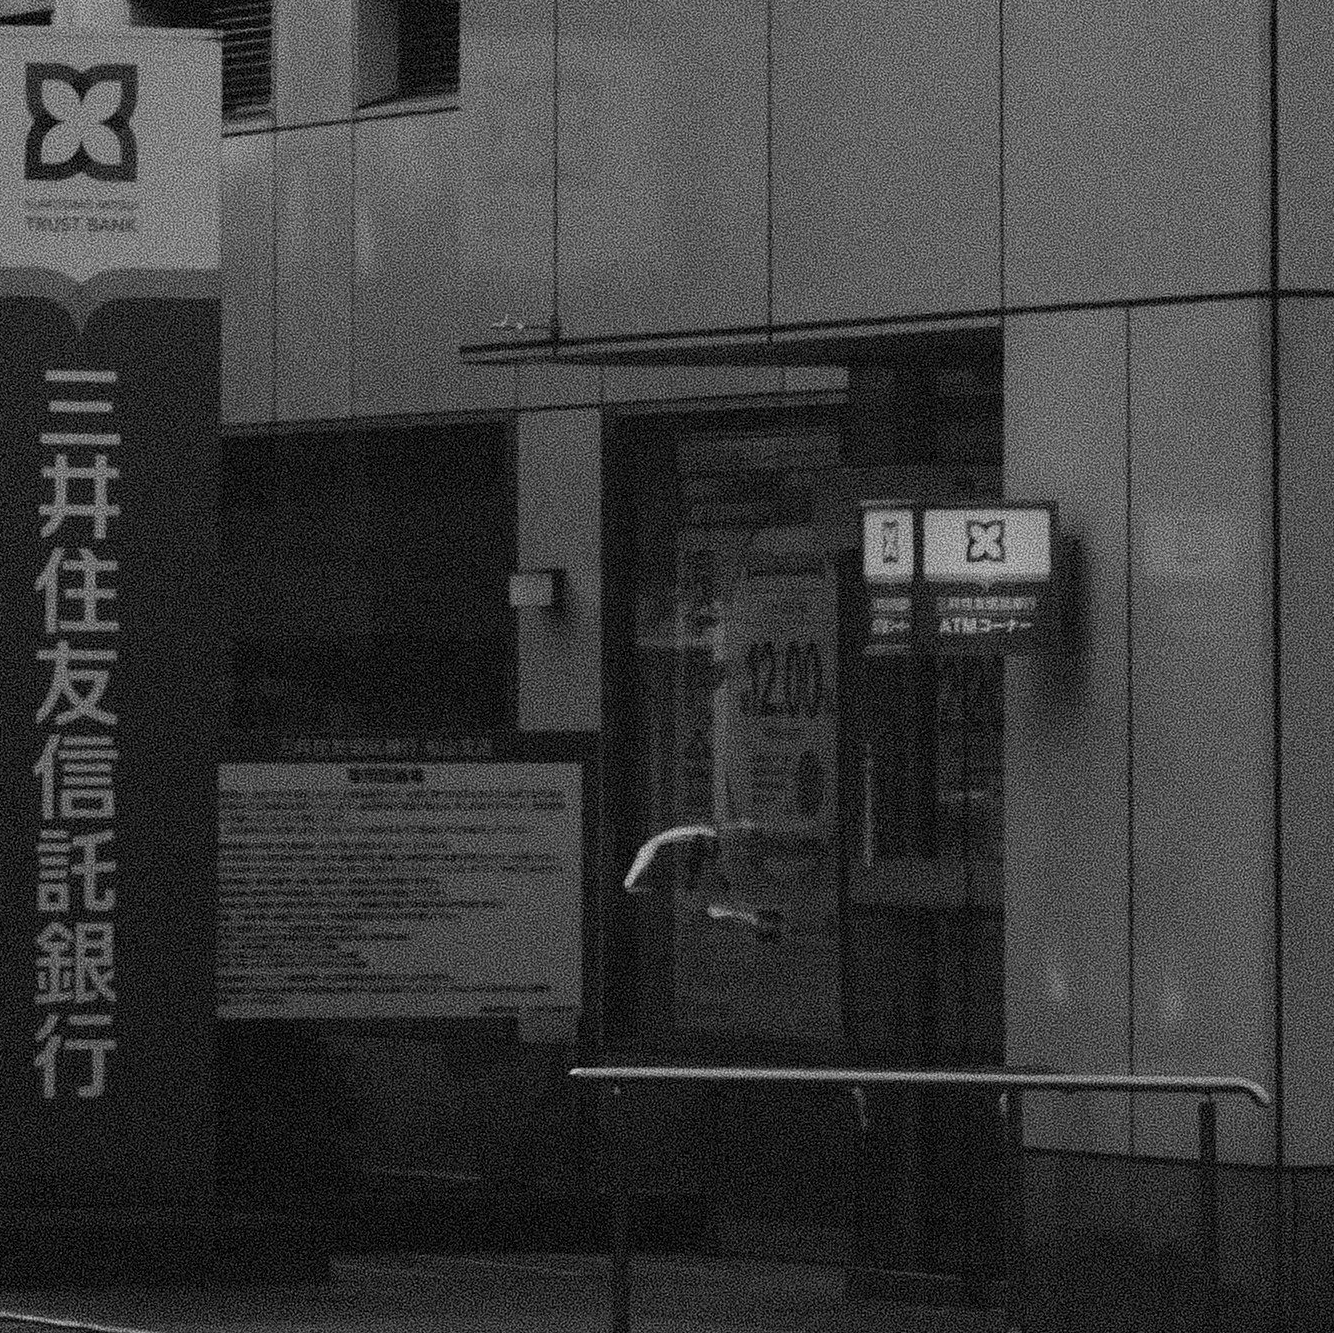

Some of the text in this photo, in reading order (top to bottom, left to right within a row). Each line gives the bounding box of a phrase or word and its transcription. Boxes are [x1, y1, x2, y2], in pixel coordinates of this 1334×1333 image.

[25, 215, 139, 233] TRUST BANK
[938, 617, 1033, 634] ATMコーナー
[32, 368, 122, 1101] 三井住友信託銀行
